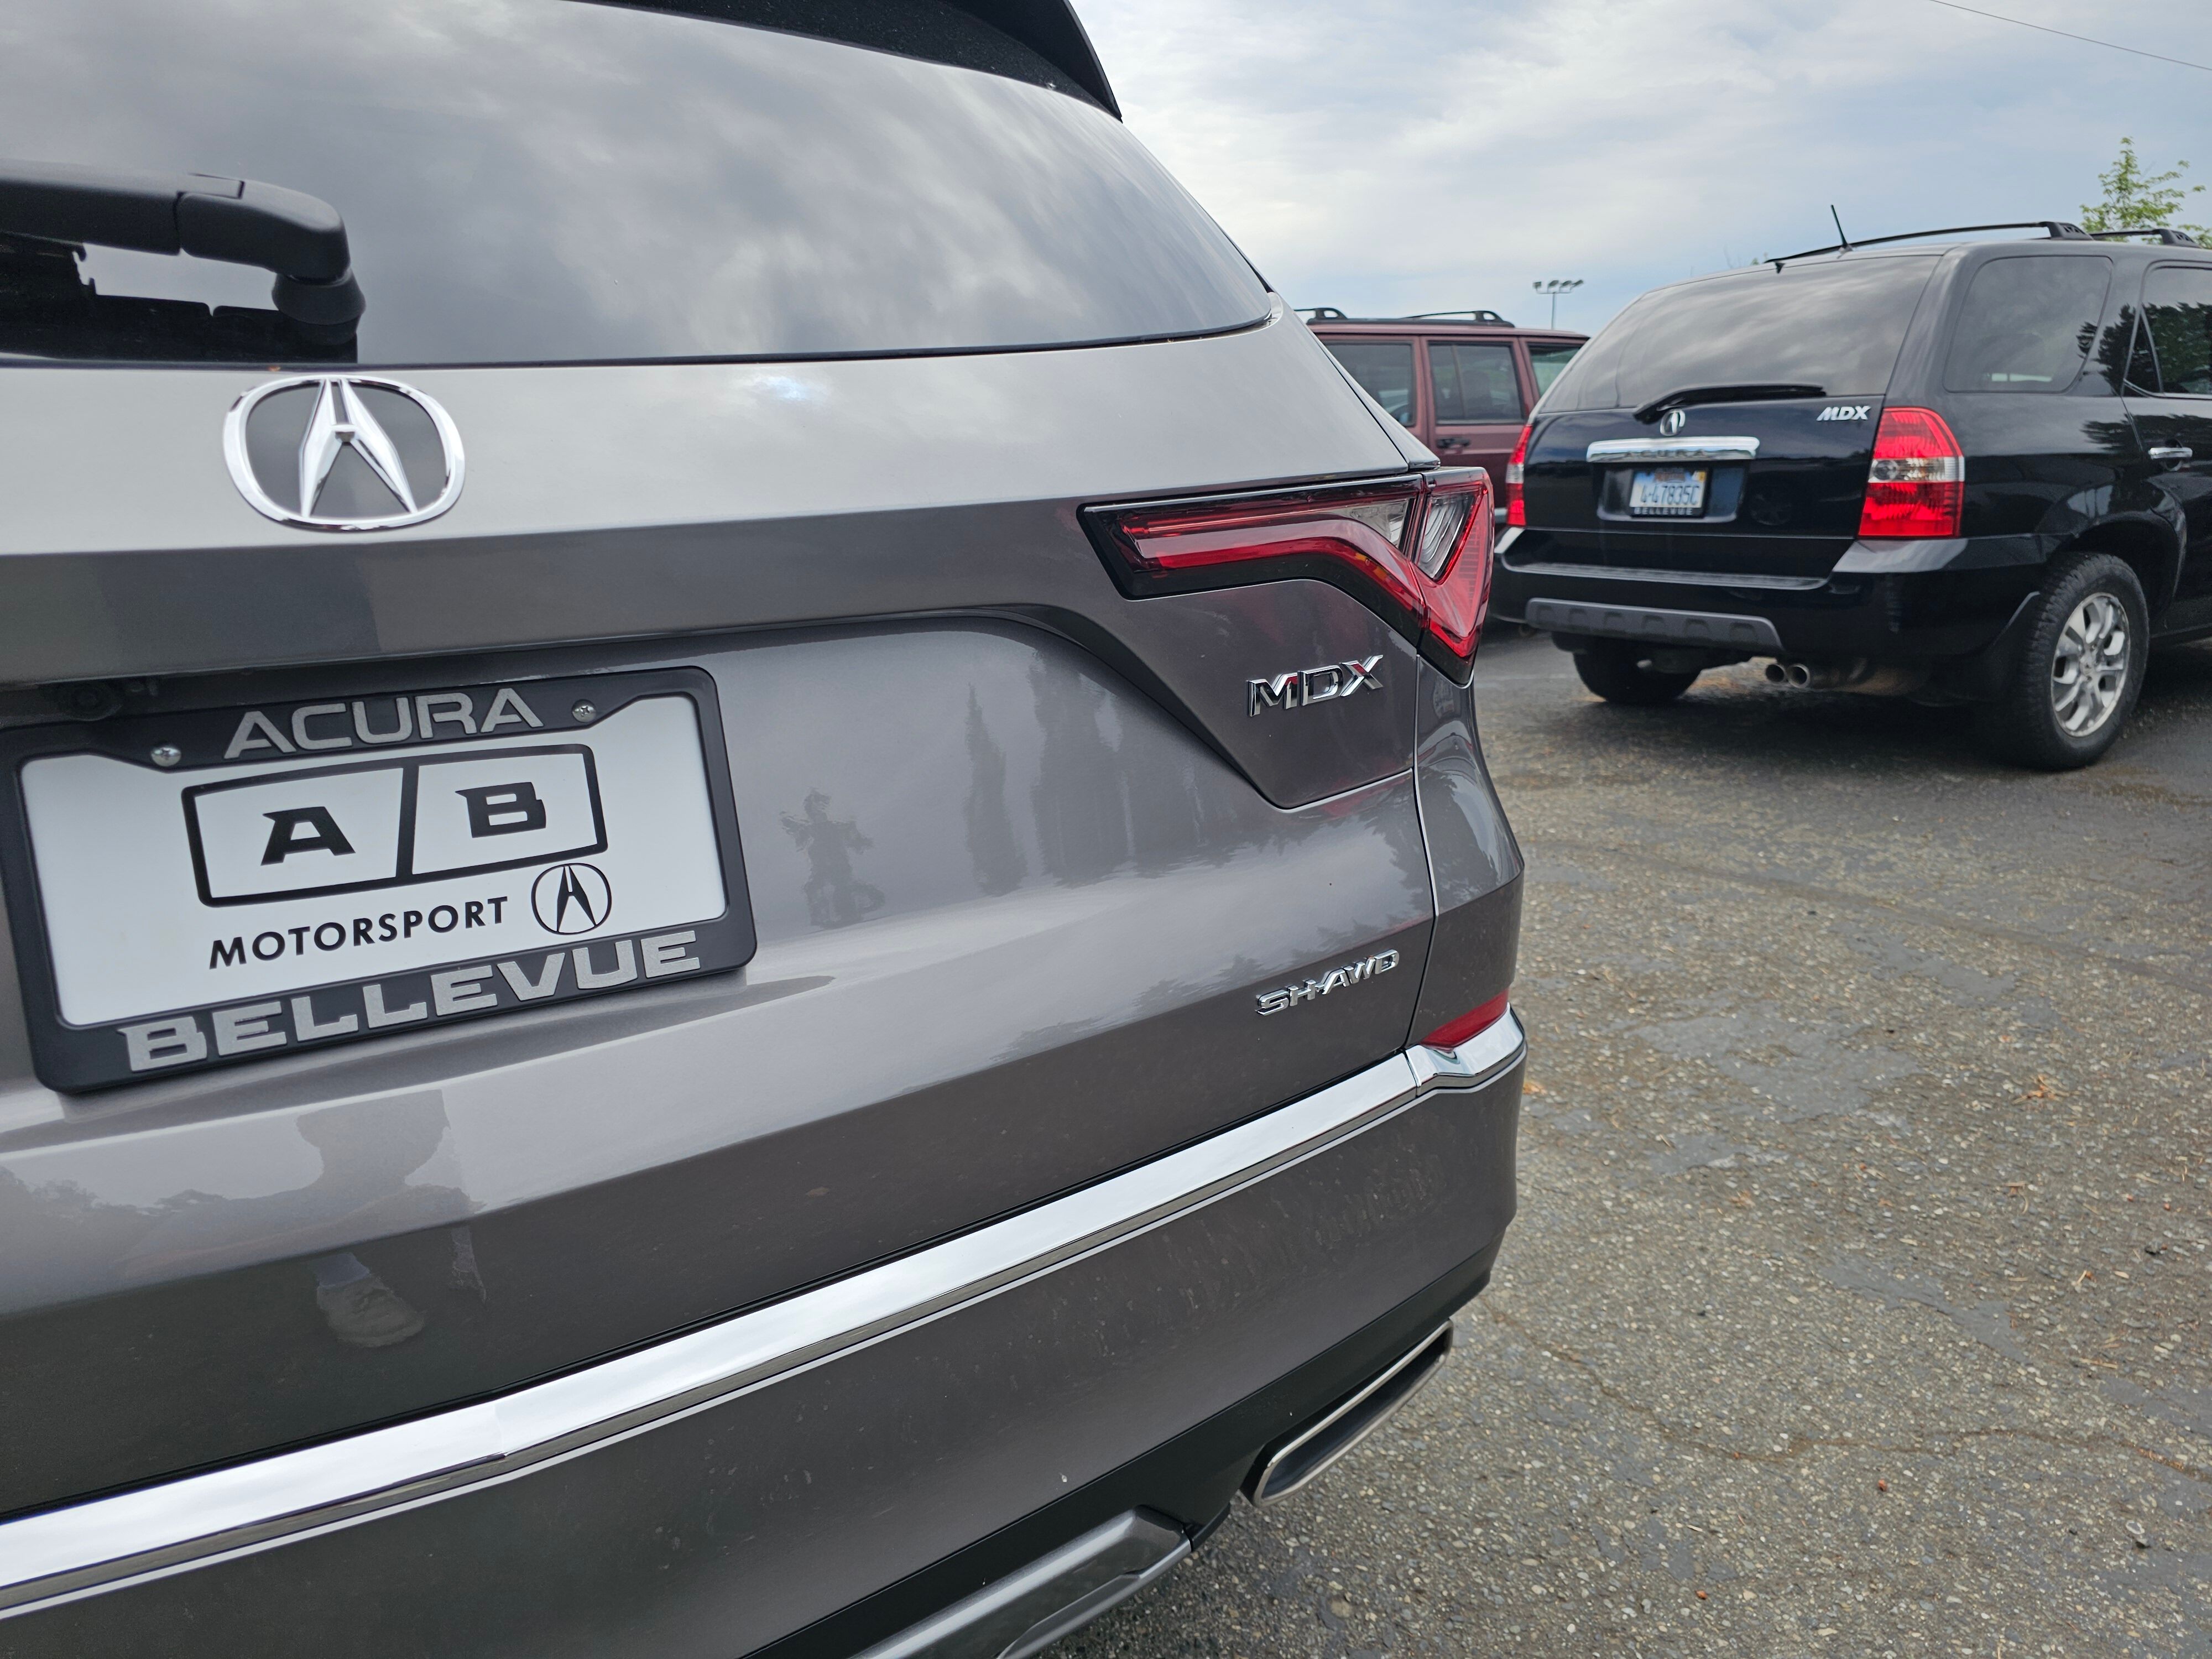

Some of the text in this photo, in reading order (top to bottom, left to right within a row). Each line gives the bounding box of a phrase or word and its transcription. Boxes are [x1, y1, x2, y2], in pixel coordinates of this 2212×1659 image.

[1816, 405, 1871, 421] MDX
[1624, 449, 1708, 458] ACURA
[1634, 507, 1693, 515] BELLEVUE
[1246, 654, 1384, 717] MDX
[225, 687, 544, 759] ACURA
[208, 895, 508, 970] MOTORSPORT
[116, 931, 701, 1073] BELLEVUE
